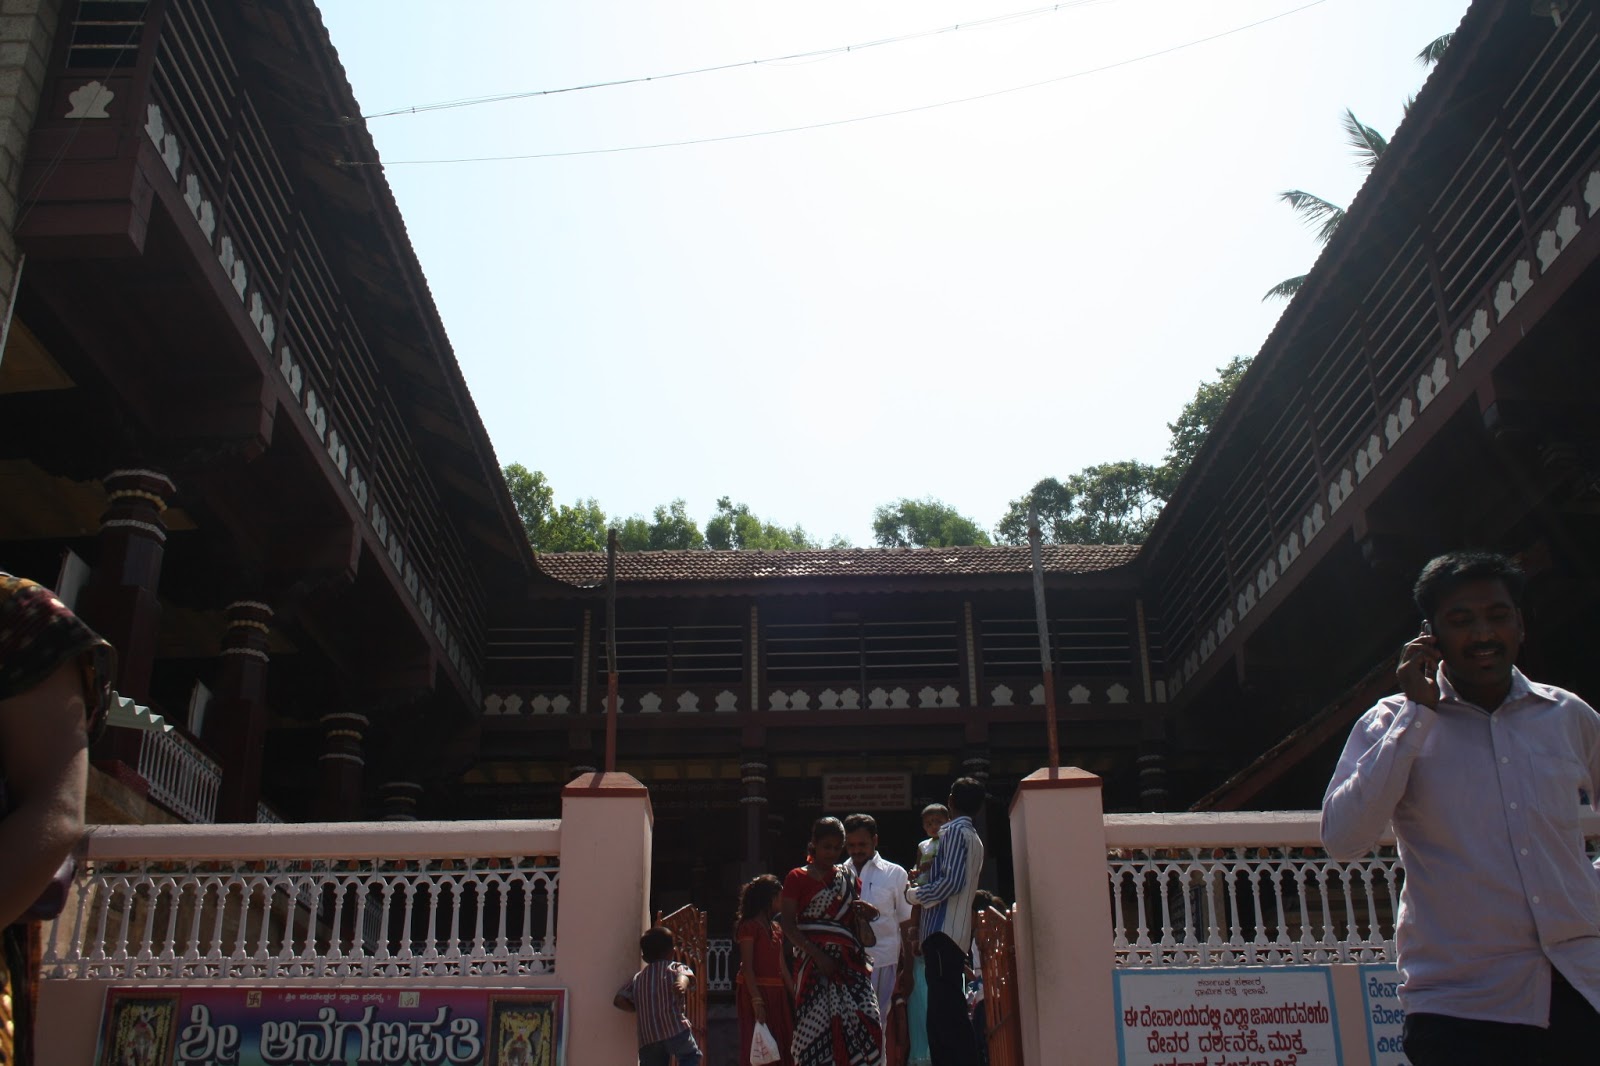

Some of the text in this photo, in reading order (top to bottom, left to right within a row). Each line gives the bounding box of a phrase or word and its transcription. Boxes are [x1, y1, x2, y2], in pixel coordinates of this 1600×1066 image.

[1124, 1006, 1138, 1027] ಈ
[1140, 1004, 1221, 1030] ದೇವಾಲಯದಲ್ಲಿ
[1223, 1007, 1249, 1031] ಎಲ್ಲಾ
[259, 1005, 482, 1064] ಆನೆಗಣಪತಿ
[1147, 1029, 1307, 1055] ದೇವರ ದರ್ಶನಕ್ಕೆ ಮುಕ್ತ
